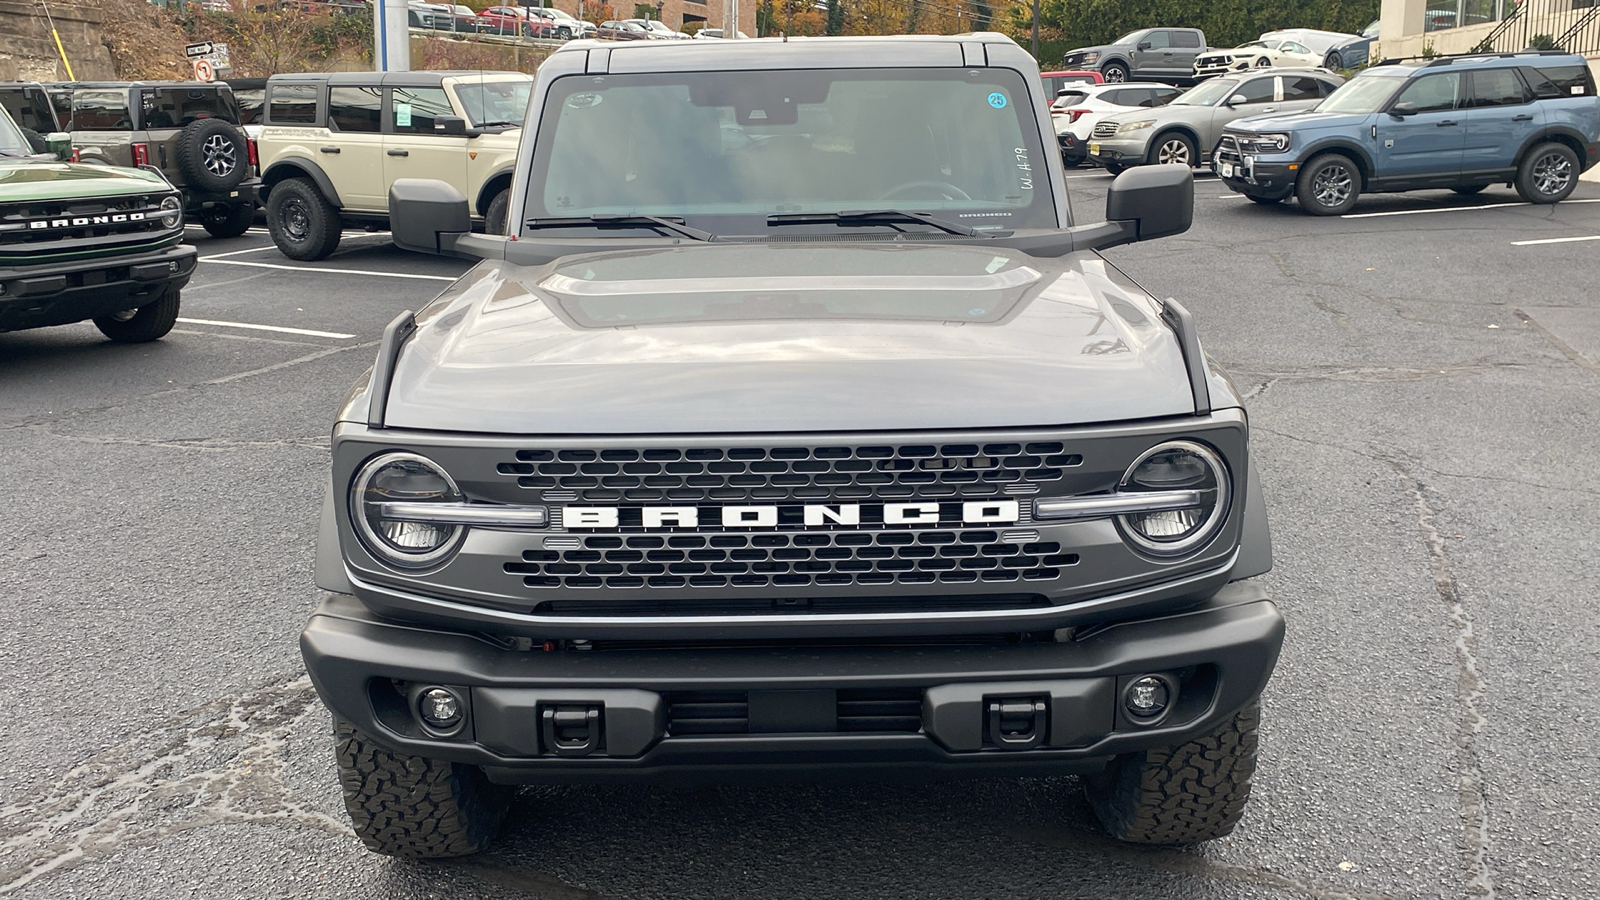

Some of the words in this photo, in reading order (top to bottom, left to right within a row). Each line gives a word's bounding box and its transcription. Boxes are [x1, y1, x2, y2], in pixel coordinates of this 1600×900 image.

[990, 95, 1004, 106] 25
[30, 213, 145, 229] BRONCO
[562, 500, 1020, 528] BRONCO
